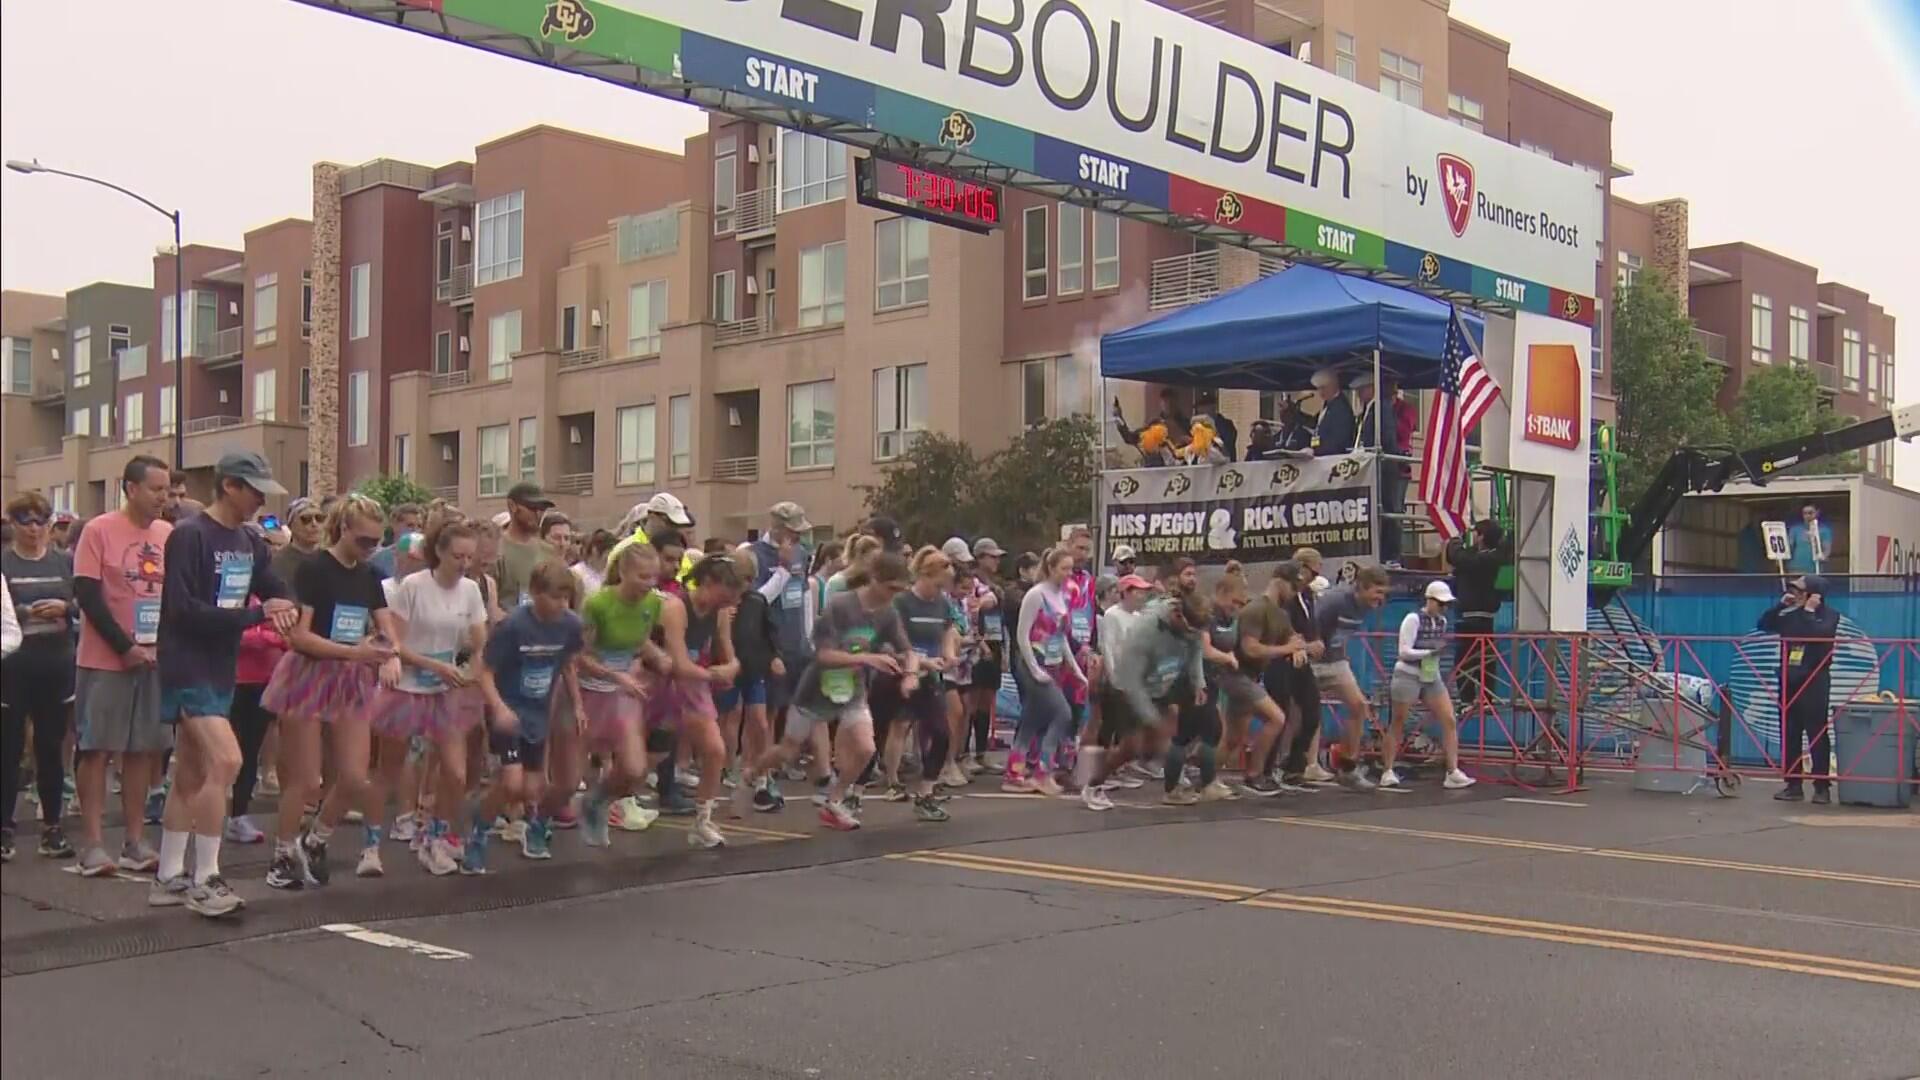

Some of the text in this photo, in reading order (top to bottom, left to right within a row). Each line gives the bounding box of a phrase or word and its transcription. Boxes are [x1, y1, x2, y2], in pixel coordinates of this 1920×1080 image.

[746, 56, 819, 103] START
[1079, 153, 1129, 190] START
[1406, 166, 1578, 249] by Runners Roost
[1317, 224, 1356, 255] START
[1495, 277, 1526, 303] START
[1110, 497, 1369, 549] MISS PEGGY & RICK GEORGE
[1243, 527, 1369, 548] ATHLETIC DIRECTOR OF CU
[1144, 537, 1179, 552] SUPER
[1181, 536, 1204, 551] FAN
[1606, 563, 1625, 577] JLG
